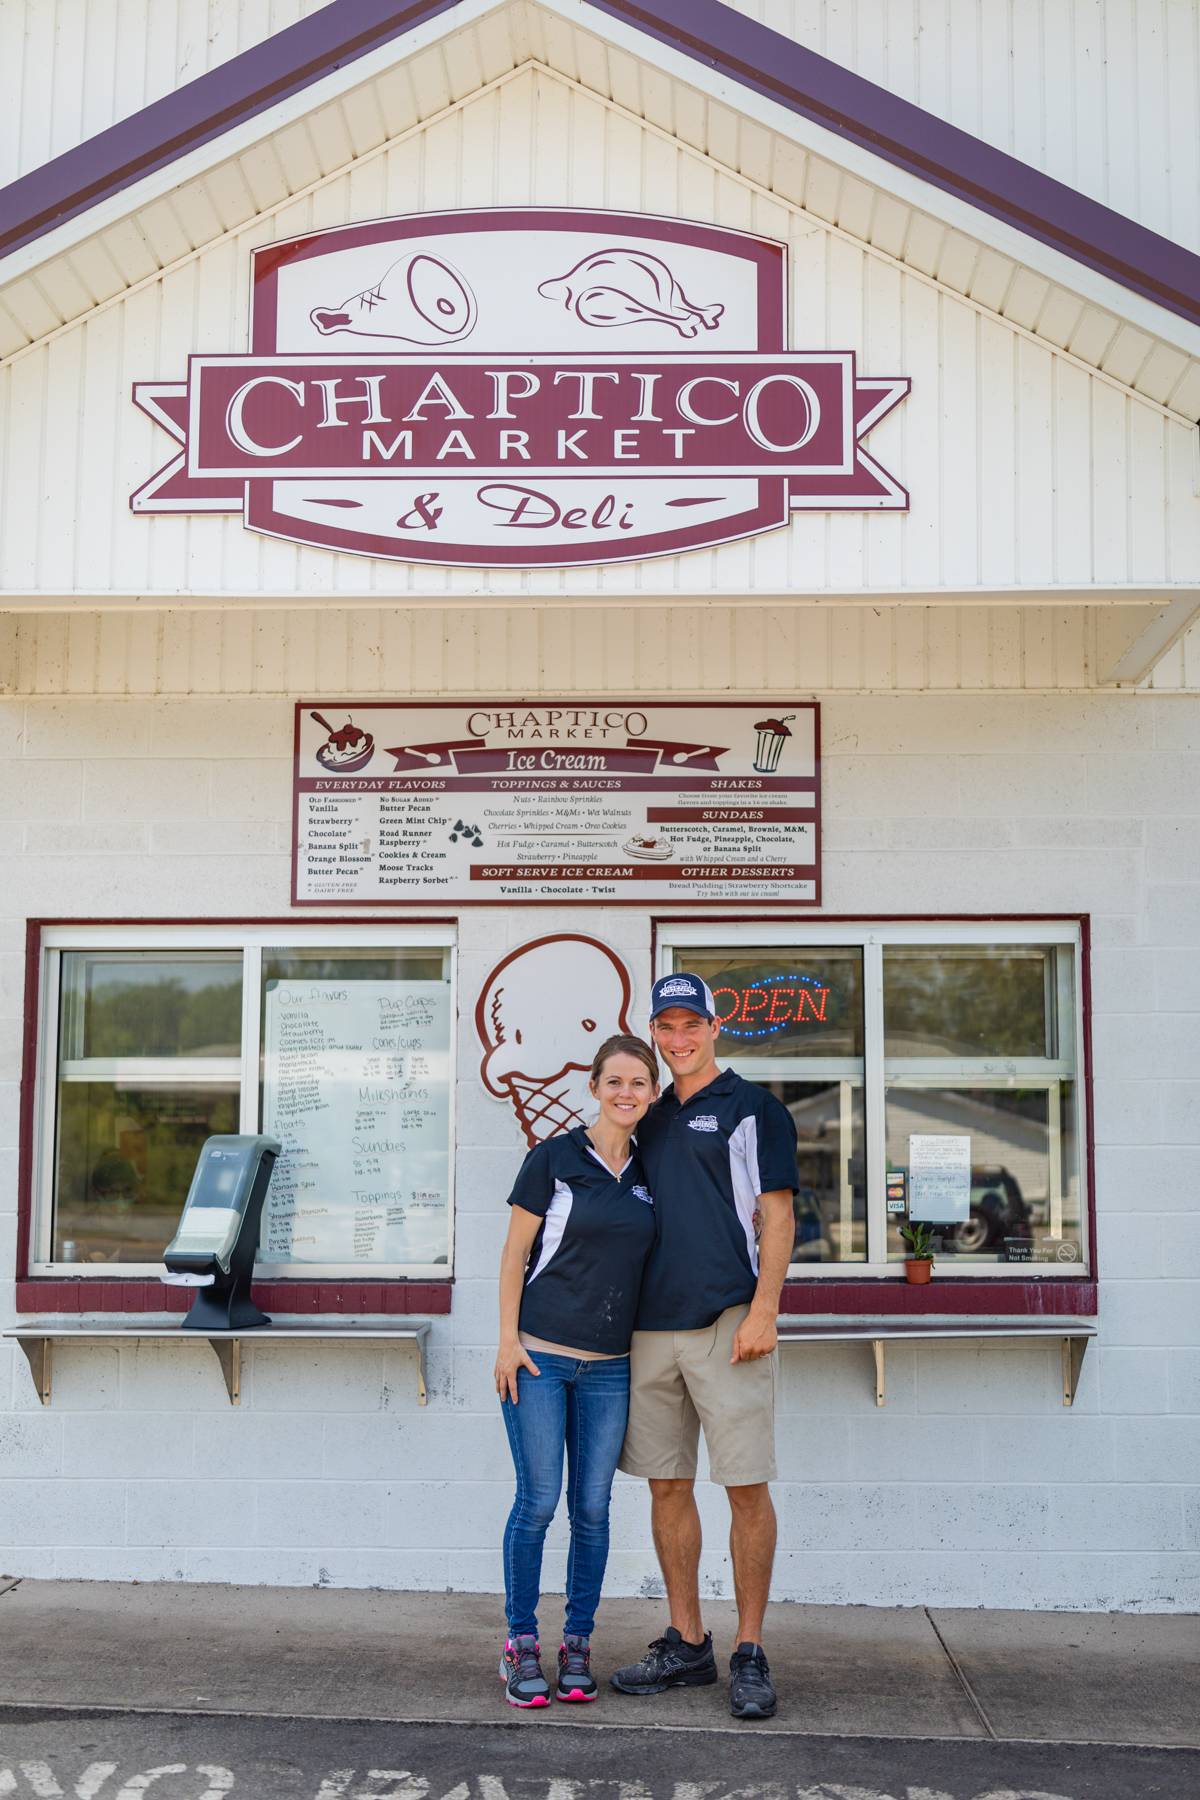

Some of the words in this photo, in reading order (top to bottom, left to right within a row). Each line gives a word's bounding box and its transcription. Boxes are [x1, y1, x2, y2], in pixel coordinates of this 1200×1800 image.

[225, 371, 820, 458] CHAPTICO
[362, 429, 695, 460] MARKET
[397, 493, 444, 532] &
[477, 483, 635, 531] Deli
[467, 711, 648, 737] CHAPTICO
[507, 729, 610, 738] MARKET
[506, 751, 535, 770] Ice
[540, 750, 607, 770] Cream
[315, 781, 384, 789] EVERYDAY
[388, 781, 446, 789] FLAVORS
[492, 780, 556, 789] TOPPINGS
[559, 780, 569, 789] &
[573, 780, 622, 789] SAUCES
[710, 780, 762, 788] SHAKES
[513, 795, 531, 803] Nuts
[537, 795, 568, 803] Rainbow
[570, 795, 603, 804] Sprinkles
[483, 808, 515, 816] Chocolate
[516, 808, 549, 818] Sprinkles
[555, 808, 580, 817] M&Ms
[587, 808, 600, 816] Wet
[602, 808, 632, 816] Walnuts
[702, 811, 764, 819] SUNDAES
[308, 818, 353, 826] Strawberry
[428, 818, 447, 826] Chip
[488, 822, 517, 830] Cherries
[523, 822, 553, 831] Whipped
[555, 822, 578, 830] Cream
[584, 822, 600, 830] Oreo
[601, 822, 627, 830] Cookies
[497, 840, 510, 848] Hot
[513, 840, 535, 849] Fudge
[540, 840, 570, 848] Caramel
[577, 840, 618, 848] Butterscotch
[687, 836, 711, 844] Fudge,
[714, 836, 753, 844] Pineapple,
[339, 843, 358, 851] Split
[743, 845, 761, 853] Split
[308, 855, 337, 864] Orange
[516, 853, 556, 862] Strawberry
[563, 853, 598, 862] Pineapple
[696, 855, 724, 864] Whipped
[765, 855, 787, 864] Cherry
[482, 868, 513, 877] SOFT
[516, 868, 558, 877] SERVE
[562, 868, 583, 877] ICE
[586, 868, 634, 877] CREAM
[682, 868, 728, 876] OTHER
[731, 868, 795, 876] DESSERTS
[379, 877, 420, 885] Raspberry
[500, 886, 532, 894] Vanilla
[540, 886, 583, 894] Chocolate
[592, 886, 615, 894] Twist
[692, 882, 723, 890] Pudding
[727, 882, 768, 890] Strawberry
[713, 987, 830, 1022] OPEN
[351, 1190, 402, 1205] Toppings
